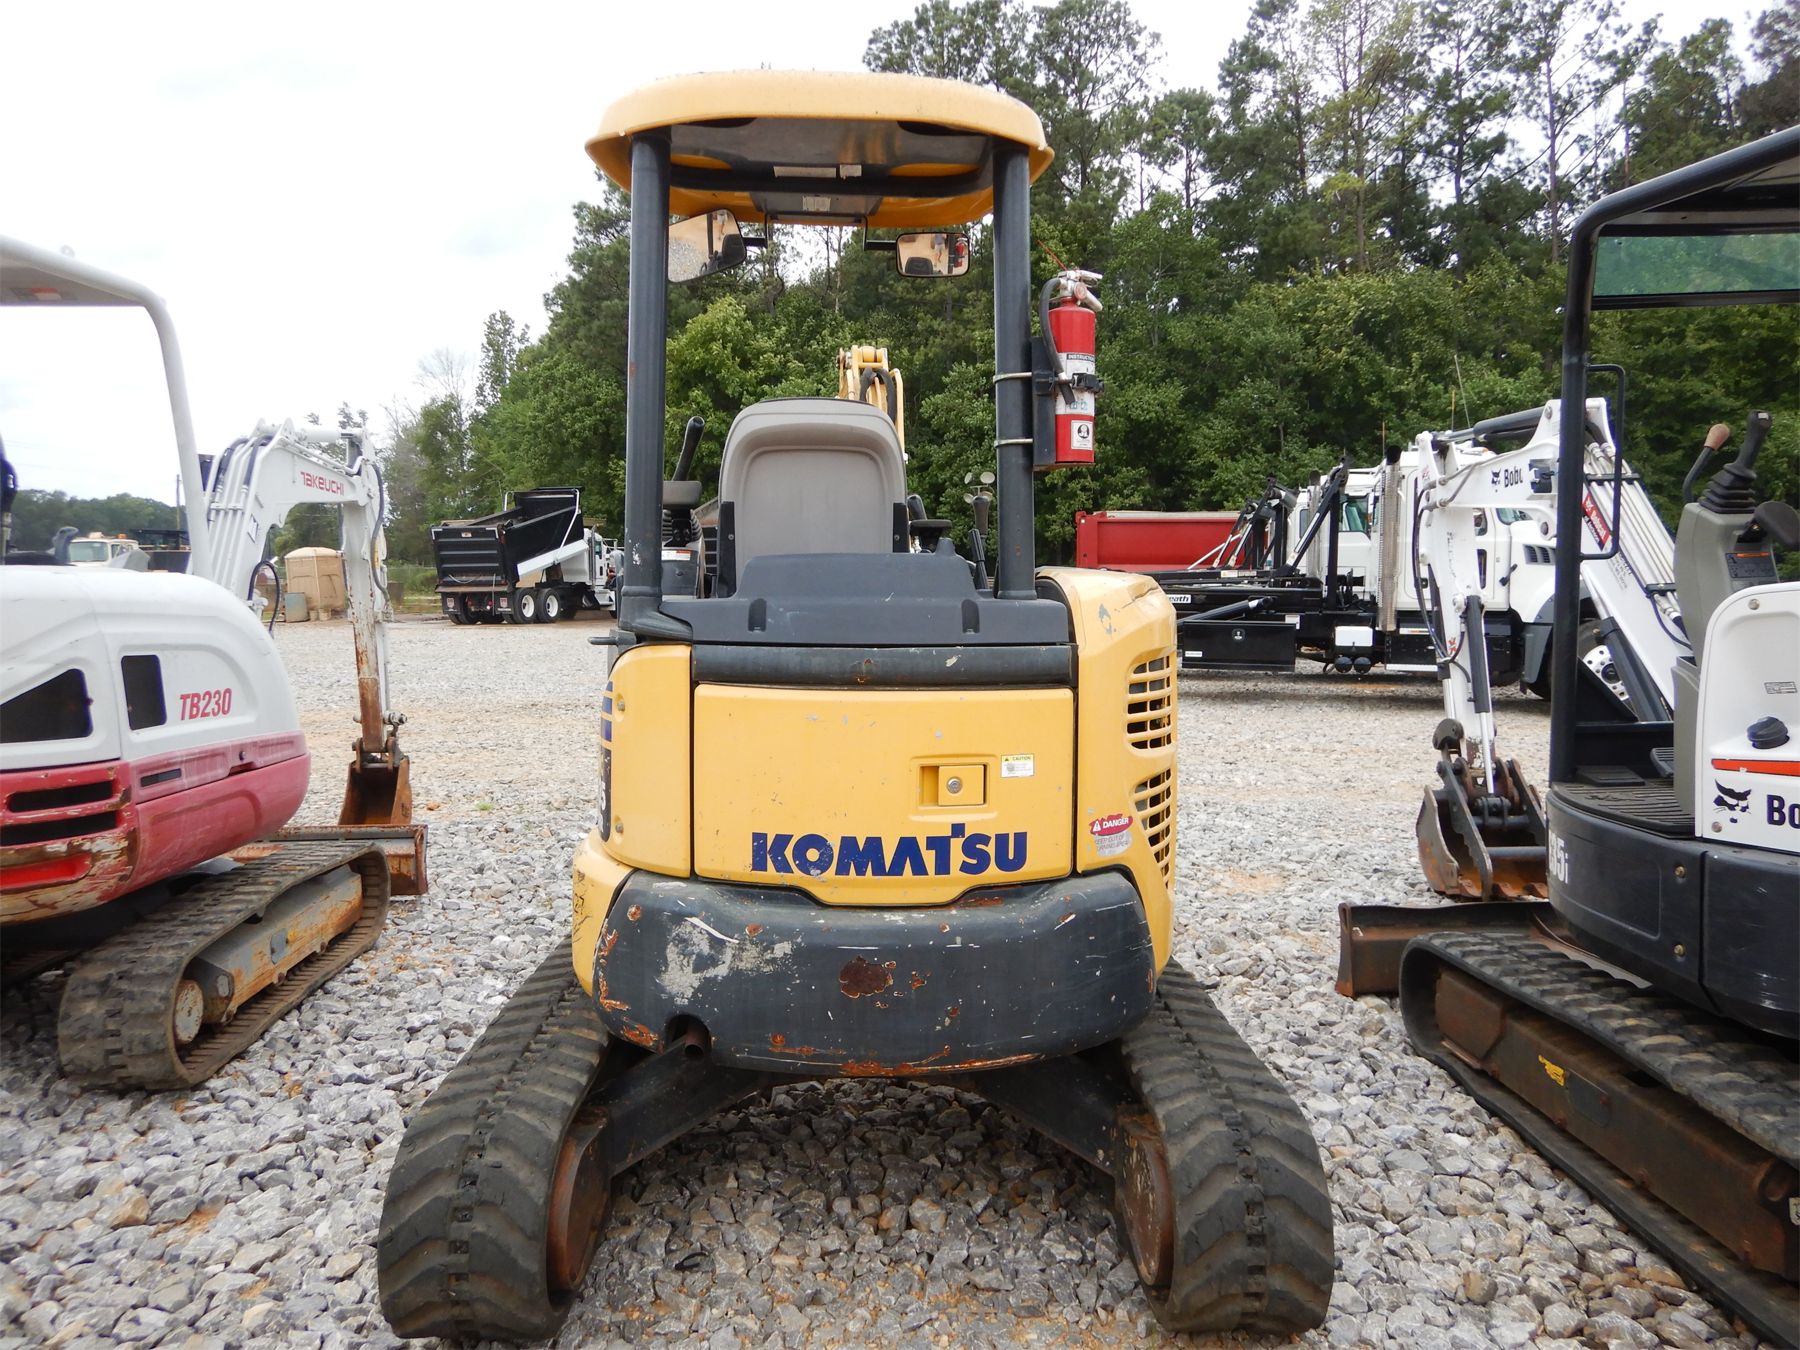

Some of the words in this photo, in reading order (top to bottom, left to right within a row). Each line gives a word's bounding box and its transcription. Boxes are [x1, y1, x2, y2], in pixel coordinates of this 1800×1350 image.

[180, 687, 232, 721] TB230
[1102, 817, 1129, 829] DANGER
[751, 822, 1028, 877] KOMATSU
